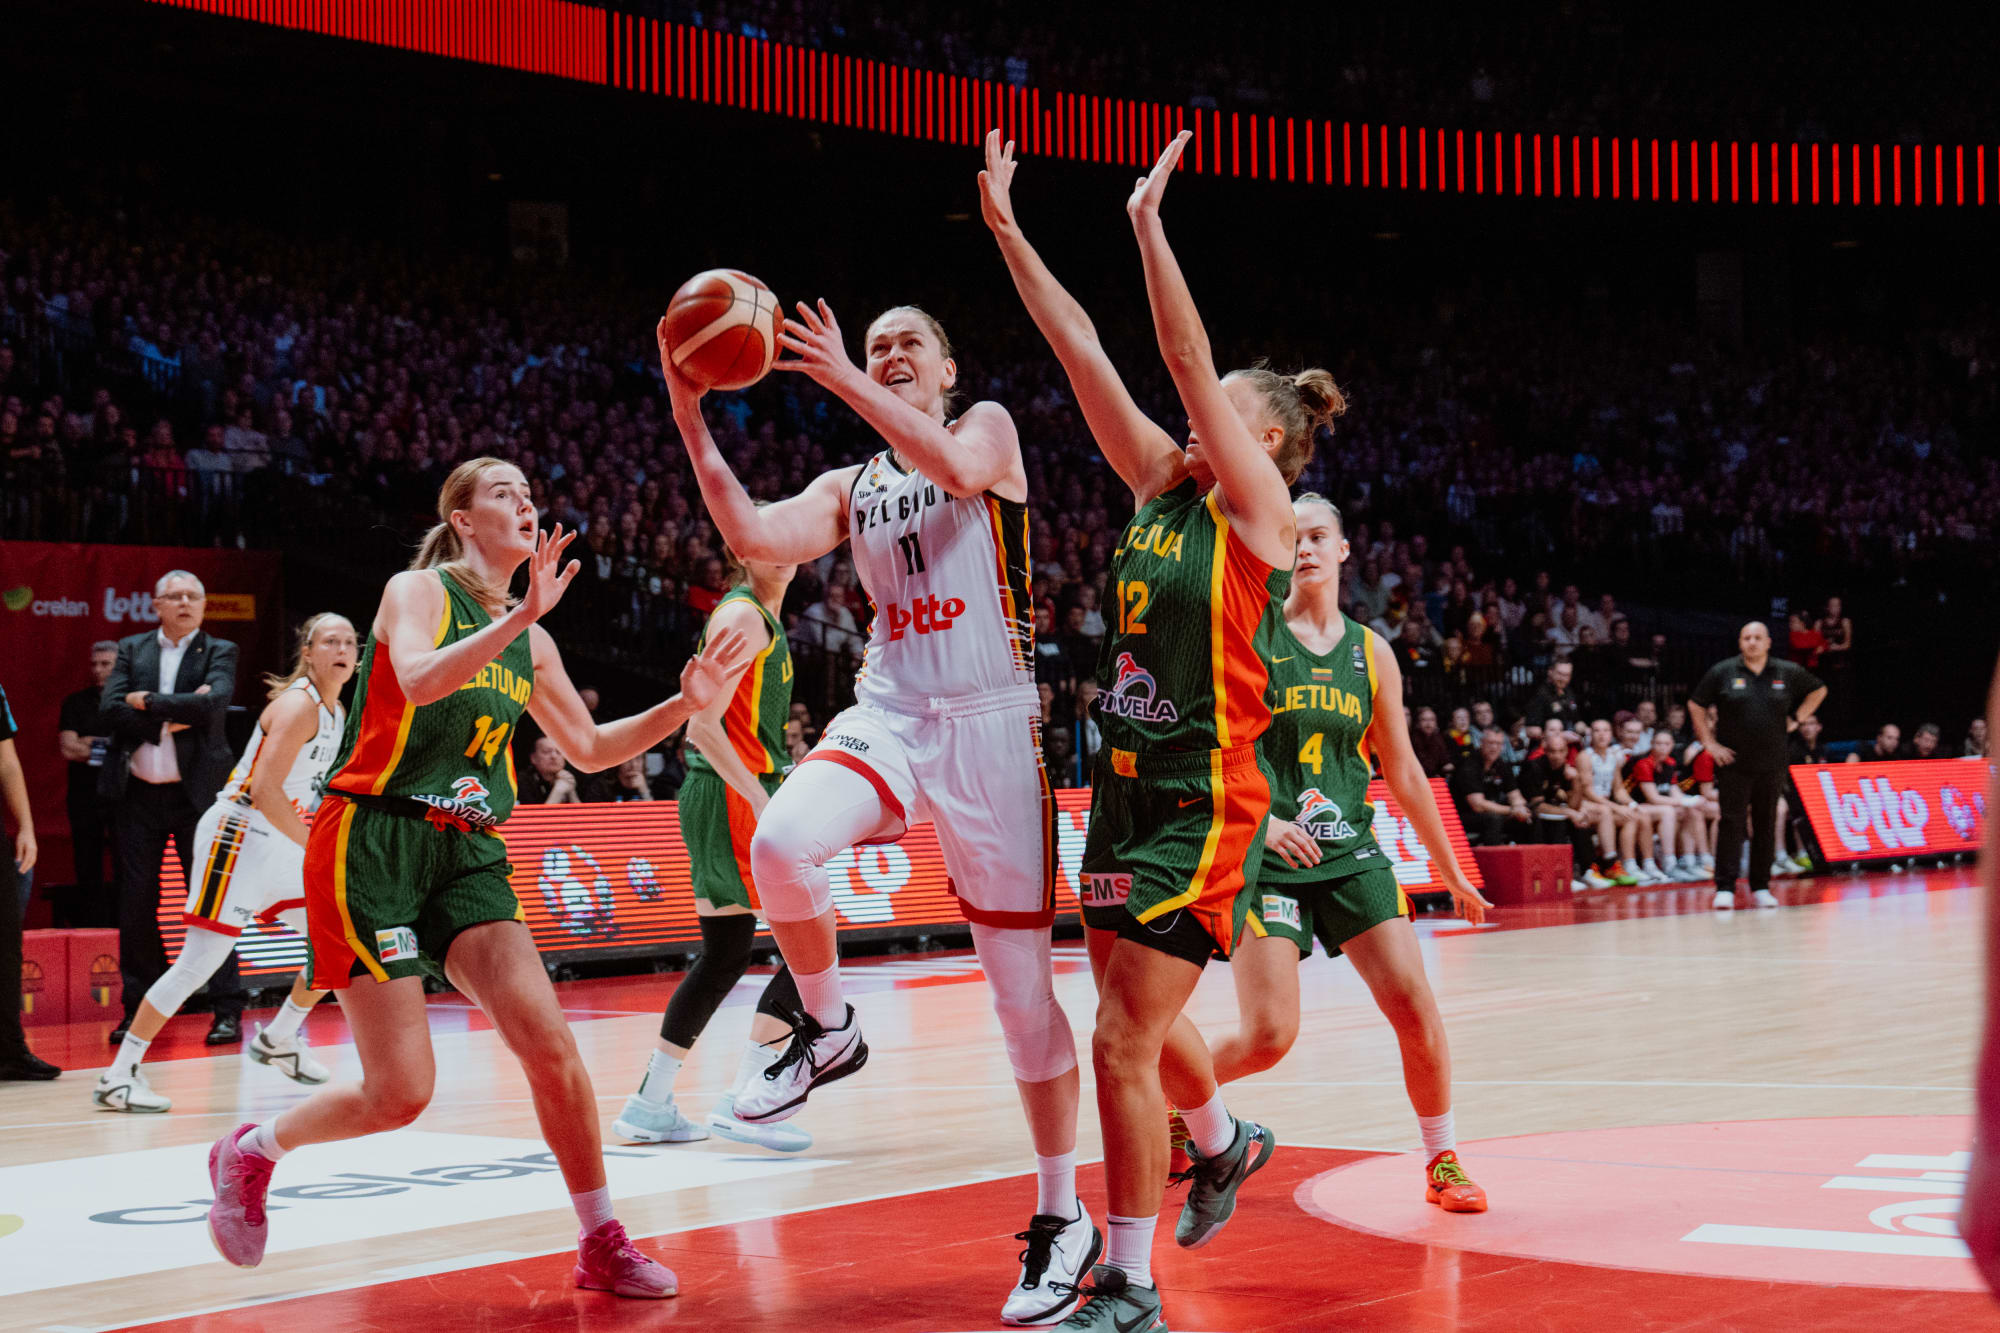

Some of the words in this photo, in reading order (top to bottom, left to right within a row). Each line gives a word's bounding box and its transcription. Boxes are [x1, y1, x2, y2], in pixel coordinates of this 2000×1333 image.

[898, 532, 926, 576] 11
[32, 596, 90, 617] crelan
[104, 587, 158, 622] lott
[886, 594, 966, 642] lotto
[1117, 580, 1149, 634] 12
[1097, 688, 1179, 722] BIVELA
[1272, 684, 1363, 724] LIETUVA
[464, 715, 510, 767] 14
[1298, 732, 1324, 775] 4
[1292, 820, 1358, 841] VELA
[1817, 771, 1929, 852] lotto
[88, 1149, 659, 1225] celan
